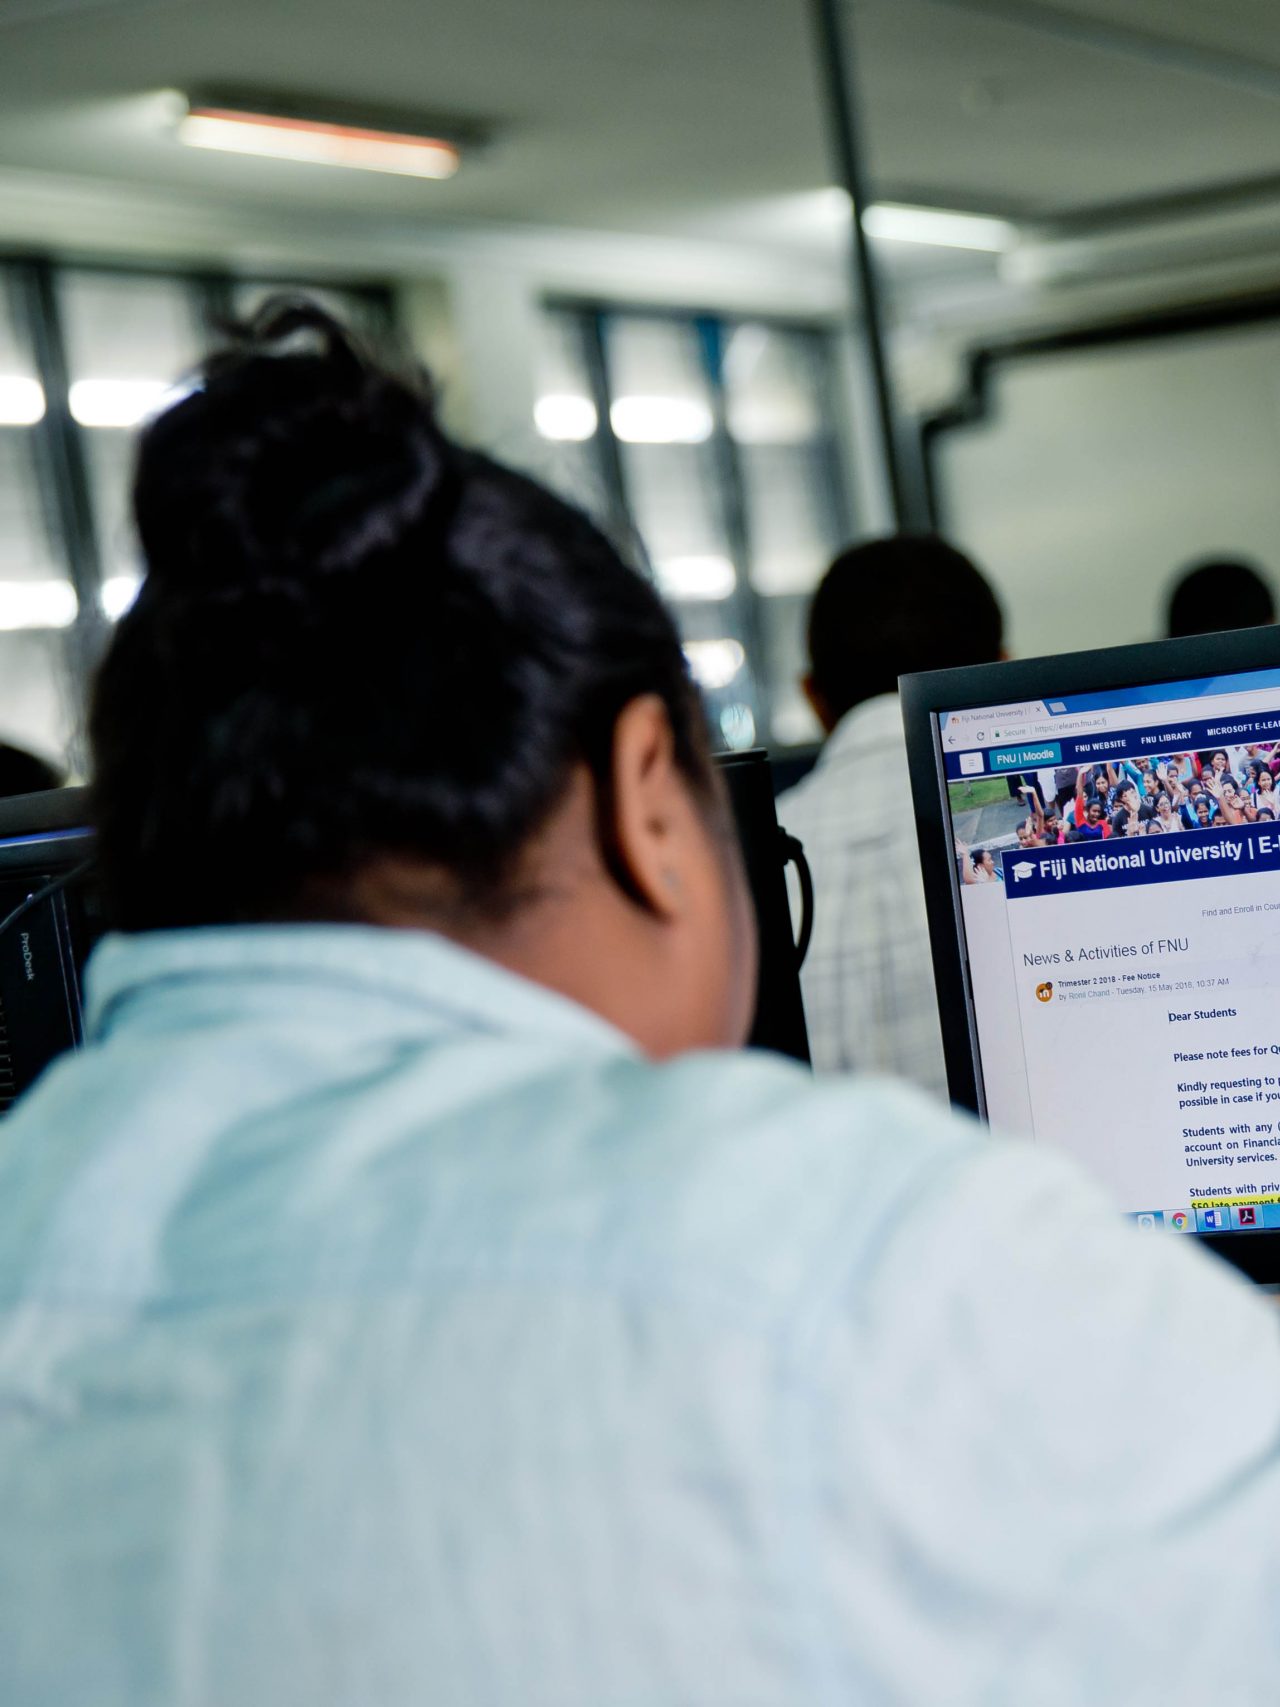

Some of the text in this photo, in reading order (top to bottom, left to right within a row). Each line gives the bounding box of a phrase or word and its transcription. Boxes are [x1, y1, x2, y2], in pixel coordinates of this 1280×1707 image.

[971, 712, 994, 720] National
[996, 709, 1023, 718] University
[1004, 728, 1026, 737] Secure
[1207, 723, 1253, 736] MICROSOFT
[1141, 731, 1192, 745] FNU LIBRARY
[1075, 739, 1127, 752] FNU WEBSITE
[997, 754, 1016, 764] FNU
[1023, 750, 1054, 761] Moodle
[1039, 858, 1067, 880] Fiji
[1071, 850, 1146, 875] National
[1149, 840, 1243, 866] University
[1201, 909, 1218, 918] Find
[1219, 907, 1232, 916] and
[1234, 904, 1254, 914] Enroll
[1256, 904, 1262, 912] in
[20, 932, 35, 981] ProDesk
[1023, 937, 1190, 967] News & Activities of FNU
[1058, 978, 1091, 988] Trimester
[1092, 977, 1098, 985] 2
[1099, 976, 1116, 984] 2018
[1122, 973, 1136, 982] Fee
[1137, 971, 1161, 980] Notice
[1058, 993, 1067, 1002] by
[1087, 989, 1110, 998] Chand
[1149, 984, 1158, 992] 15
[1158, 983, 1173, 993] May
[1216, 978, 1230, 986] AM
[1168, 1007, 1237, 1023] Dear Students
[1173, 1052, 1204, 1063] Please
[1206, 1049, 1229, 1060] note
[1231, 1047, 1251, 1058] fees
[1253, 1046, 1268, 1056] for
[1177, 1080, 1208, 1093] Kindly
[1210, 1077, 1262, 1091] requesting
[1264, 1076, 1275, 1085] to
[1179, 1096, 1219, 1110] possible
[1221, 1095, 1230, 1105] in
[1232, 1093, 1254, 1104] case
[1255, 1091, 1264, 1101] if
[1182, 1125, 1225, 1138] Students
[1229, 1123, 1251, 1134] with
[1255, 1123, 1273, 1133] any
[1184, 1141, 1223, 1153] account
[1226, 1141, 1239, 1150] on
[1186, 1153, 1278, 1167] University services.
[1189, 1185, 1232, 1197] Students
[1235, 1183, 1257, 1194] with
